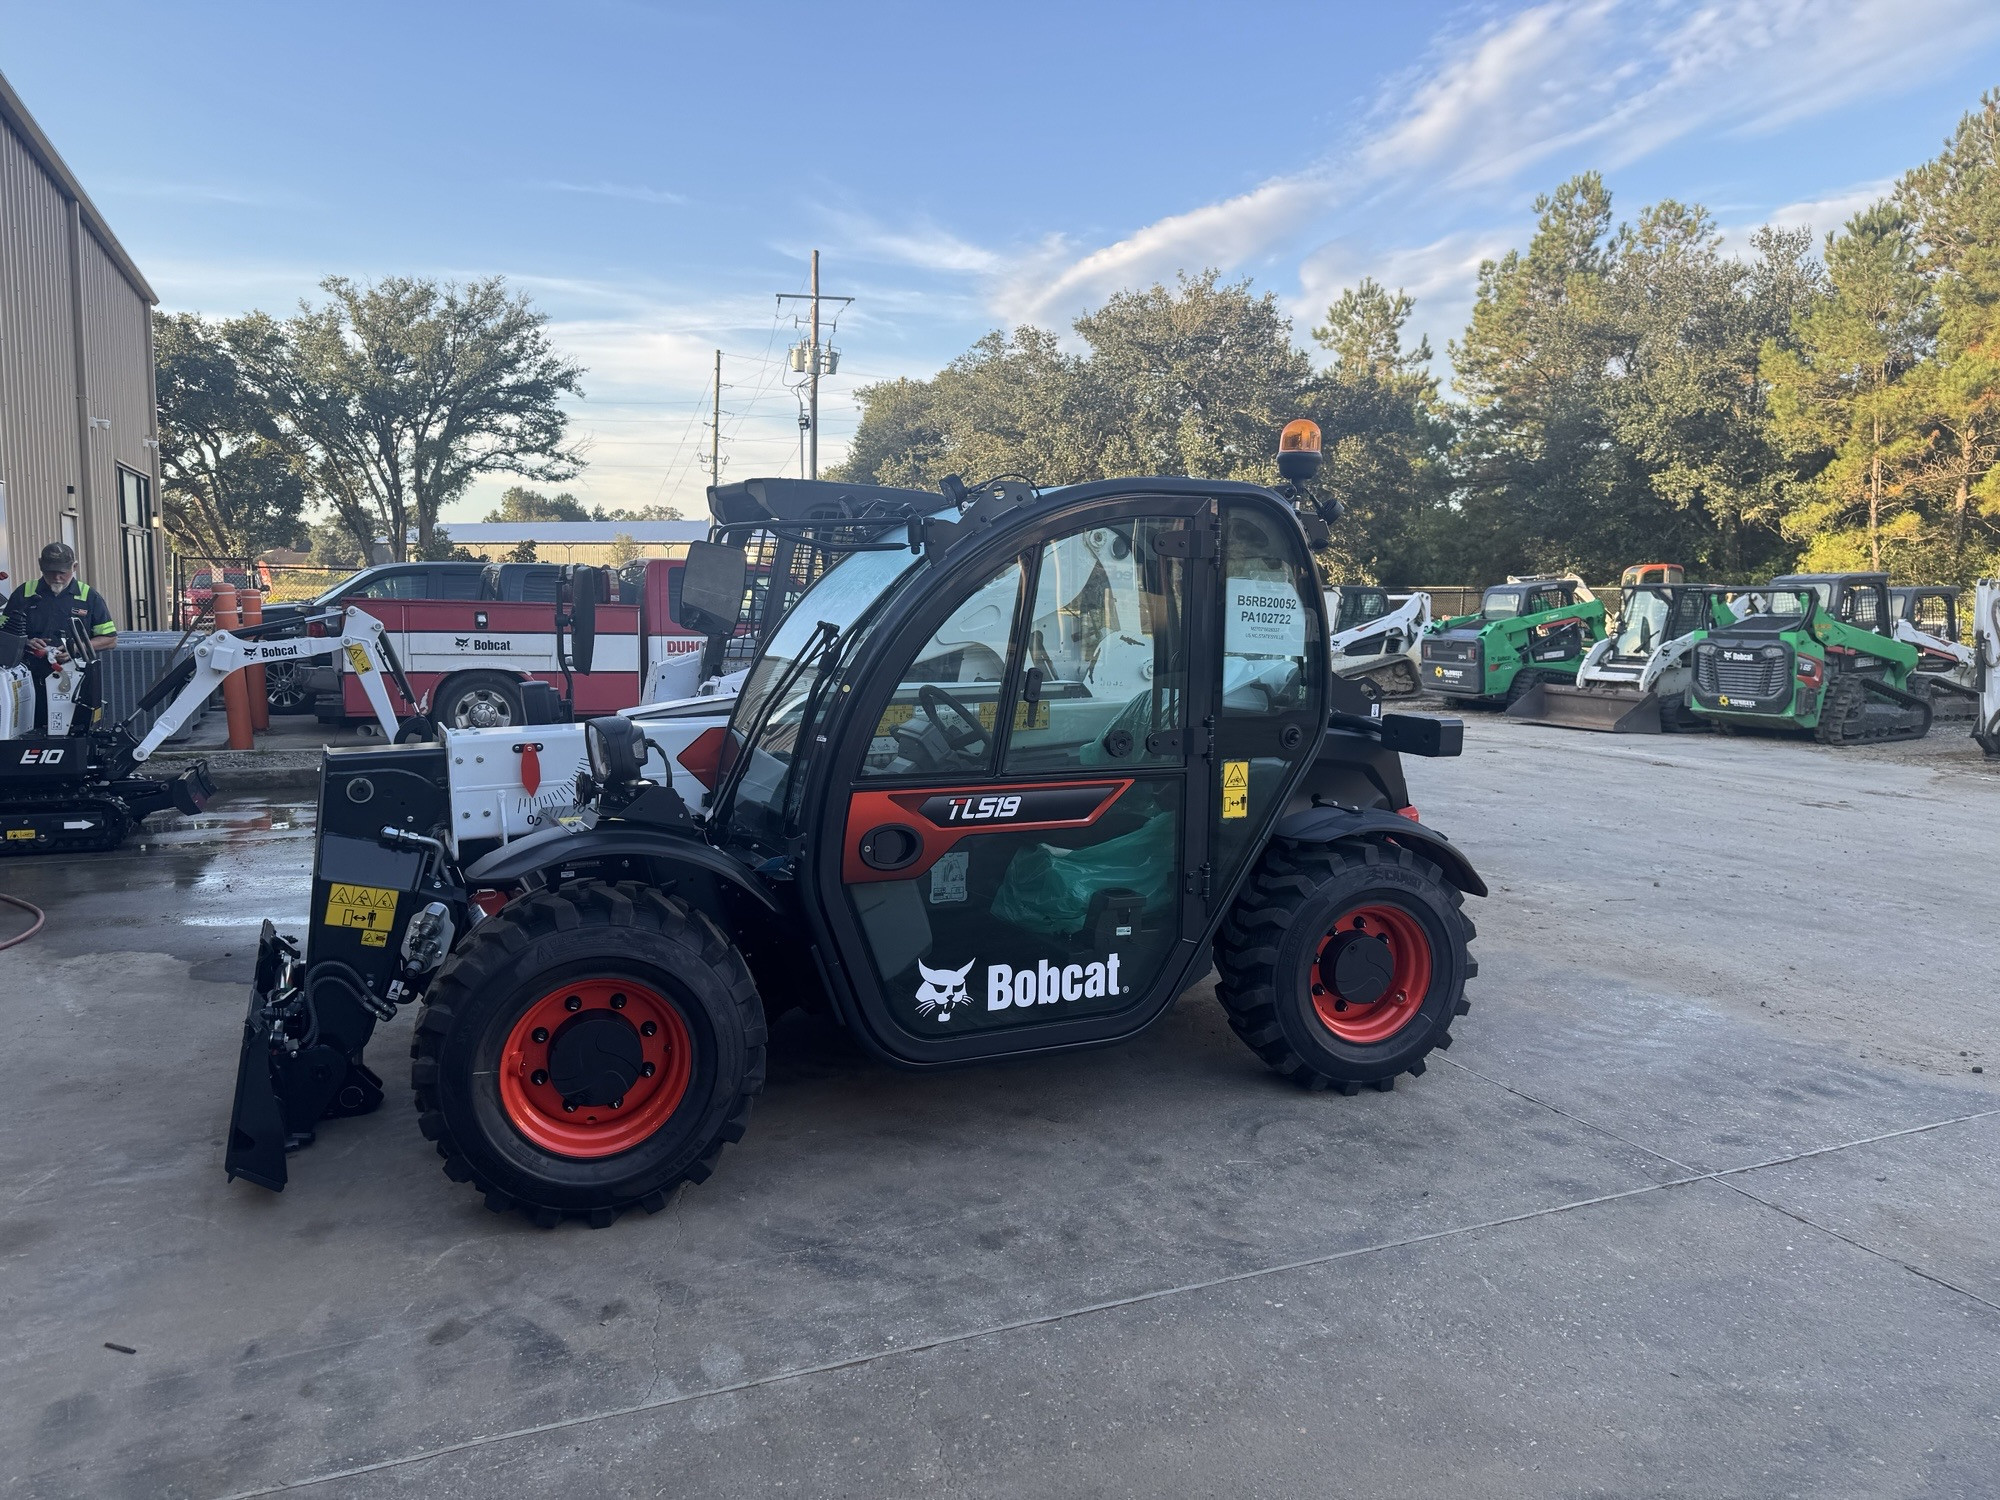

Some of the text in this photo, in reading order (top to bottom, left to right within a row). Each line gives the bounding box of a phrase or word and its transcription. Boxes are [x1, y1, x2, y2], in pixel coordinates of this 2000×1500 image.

[1237, 595, 1297, 610] B5RB20052
[1241, 611, 1292, 625] PA102722
[261, 644, 298, 658] Bobcat
[474, 639, 511, 651] Bobcat
[1732, 652, 1754, 662] Bobcat
[20, 748, 65, 765] E10
[987, 952, 1121, 1012] Bobcat
